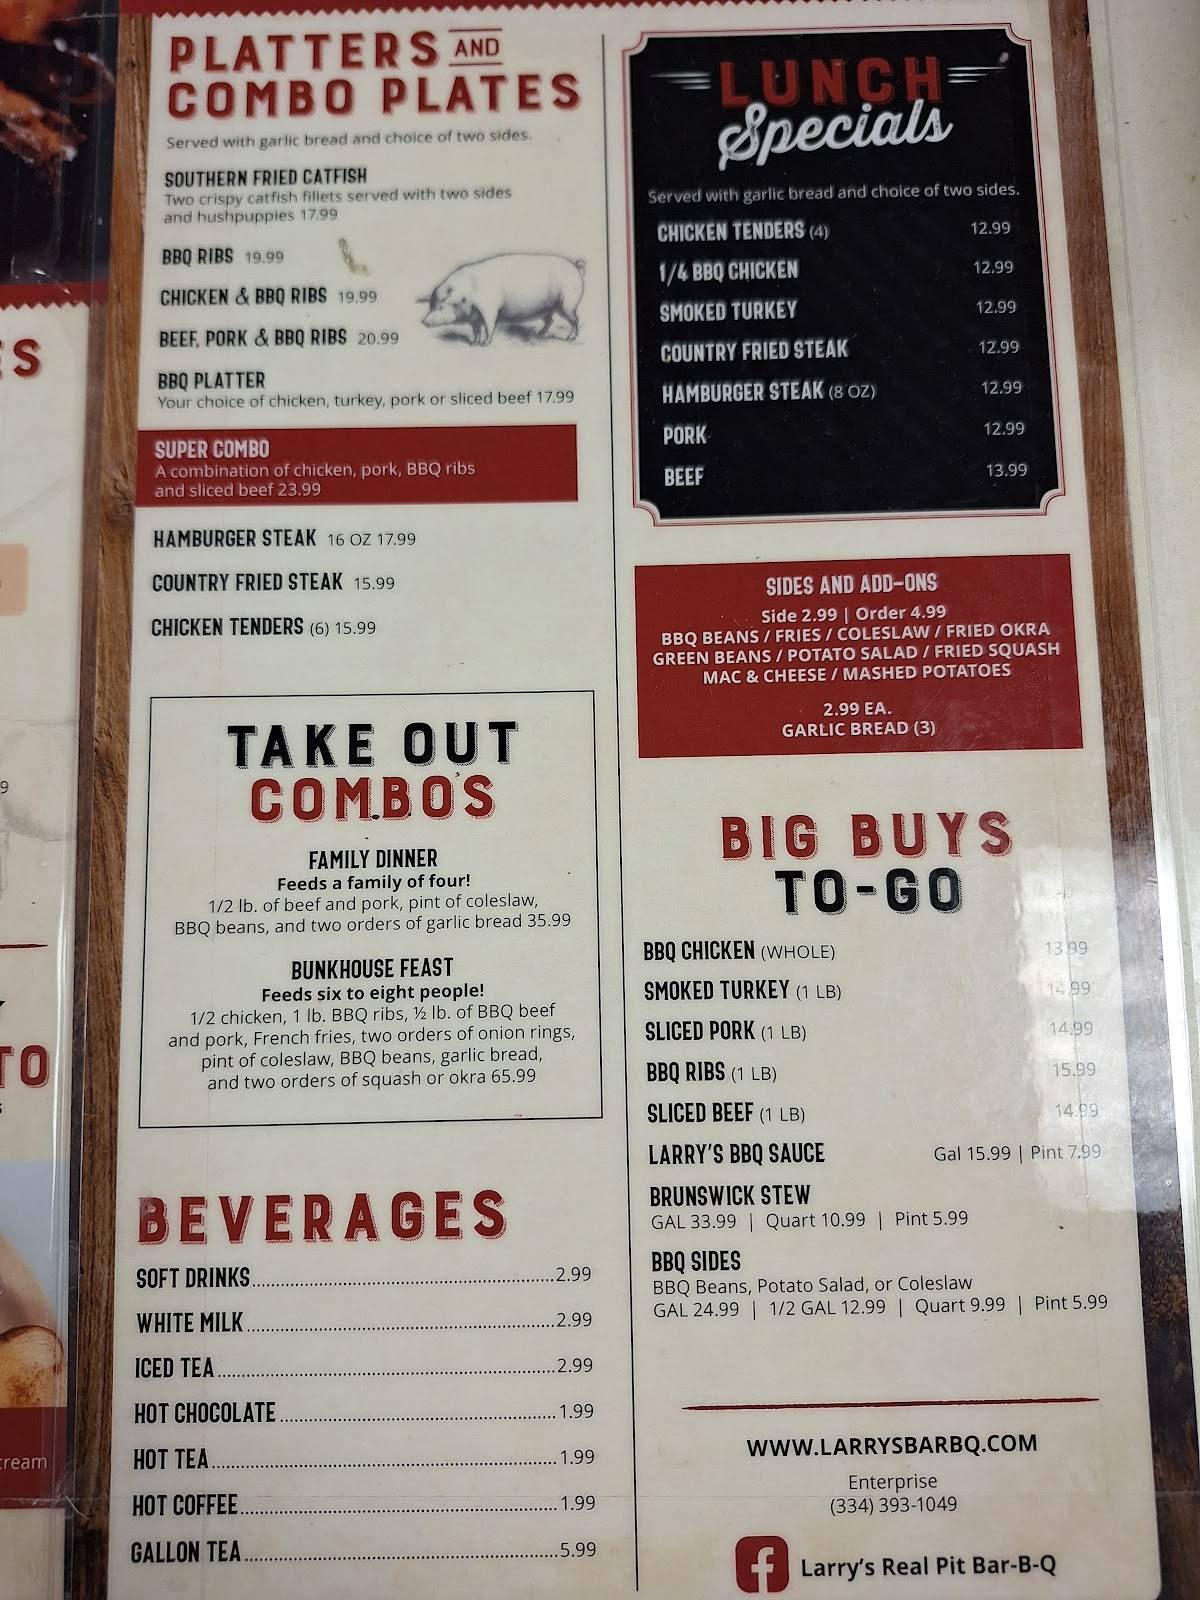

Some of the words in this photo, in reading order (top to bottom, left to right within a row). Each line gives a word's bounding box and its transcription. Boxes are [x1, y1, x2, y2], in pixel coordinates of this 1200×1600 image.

[169, 30, 439, 73] PLATTERS
[453, 38, 500, 58] AND
[718, 56, 944, 108] LUNCH
[168, 78, 354, 119] COMBO
[381, 72, 580, 115] PLATES
[717, 99, 954, 172] Specials
[164, 170, 248, 188] SOUTHERN
[253, 168, 298, 186] FRIED
[303, 167, 367, 185] CATFISH
[163, 210, 193, 225] and
[197, 209, 295, 225] hushpuppies
[300, 207, 338, 222] 17.99
[657, 221, 728, 243] CHICKEN
[731, 220, 806, 241] TENDERS
[809, 225, 830, 241] (4)
[970, 221, 1011, 235] 12.99
[162, 248, 192, 267] BBQ
[197, 247, 234, 265] RIBS
[246, 250, 285, 265] 19.99
[659, 262, 689, 287] 1/4
[692, 261, 725, 283] BBQ
[727, 259, 799, 281] CHICKEN
[973, 260, 1014, 275] 12.99
[160, 288, 229, 307] CHICKEN
[235, 286, 249, 306] &
[255, 287, 285, 307] BBQ
[291, 286, 327, 304] RIBS
[339, 290, 378, 304] 19.99
[659, 301, 727, 323] SMOKED
[730, 299, 798, 321] TURKEY
[976, 300, 1017, 314] 12.99
[159, 330, 199, 348] BEEF,
[205, 329, 247, 347] PORK
[254, 328, 269, 347] &
[274, 328, 305, 348] BBQ
[310, 327, 347, 346] RIBS
[358, 331, 399, 346] 20.99
[660, 341, 738, 363] COUNTRY
[741, 340, 790, 361] FRIED
[793, 338, 849, 360] STEAK
[978, 340, 1020, 355] 12.99
[158, 372, 189, 392] BBQ
[194, 371, 265, 389] PLATTER
[662, 381, 764, 404] HAMBURGER
[768, 380, 824, 401] STEAK
[828, 385, 844, 401] (8
[847, 383, 876, 400] OZ)
[981, 380, 1023, 395] 12.99
[663, 424, 707, 446] PORK
[983, 421, 1025, 436] 12.99
[154, 439, 208, 460] SUPER
[212, 438, 270, 459] COMBO
[155, 464, 167, 479] A
[170, 463, 269, 479] combination
[273, 463, 291, 478] of
[293, 461, 357, 478] chicken,
[361, 461, 402, 480] pork,
[407, 461, 442, 478] BBQ
[446, 460, 476, 475] ribs
[664, 466, 704, 487] BEEF
[986, 463, 1028, 478] 13.99
[154, 483, 185, 498] and
[189, 482, 234, 498] sliced
[238, 482, 275, 497] beef
[277, 482, 321, 497] 23.99
[153, 528, 257, 548] HAMBURGER
[262, 528, 317, 547] STEAK
[328, 533, 345, 547] 16
[349, 533, 372, 547] OZ
[378, 532, 416, 546] 17.99
[152, 573, 230, 593] COUNTRY
[235, 572, 283, 592] FRIED
[288, 572, 343, 591] STEAK
[354, 576, 395, 591] 15.99
[765, 575, 814, 597] SIDES
[819, 574, 855, 595] AND
[859, 572, 938, 594] ADD-ONS
[151, 617, 224, 637] CHICKEN
[229, 616, 304, 636] TENDERS
[310, 621, 330, 638] (6)
[335, 621, 376, 635] 15.99
[781, 722, 846, 738] GARLIC
[850, 721, 909, 736] BREAD
[913, 720, 936, 737] (3)
[227, 723, 375, 770] TAKE
[403, 720, 520, 767] OUT
[720, 814, 819, 862] BIG
[850, 810, 1013, 860] BUYS
[308, 849, 371, 870] FAMILY
[375, 848, 438, 869] DINNER
[277, 876, 328, 891] Feeds
[332, 879, 342, 890] a
[347, 874, 403, 893] family
[407, 873, 426, 889] of
[428, 873, 471, 888] four!
[774, 867, 963, 916] TO-GO
[643, 941, 676, 963] BBQ
[681, 939, 756, 961] CHICKEN
[761, 944, 835, 962] (WHOLE)
[291, 958, 395, 981] BUNKHOUSE
[400, 957, 454, 978] FEAST
[262, 986, 313, 1003] Feeds
[317, 986, 342, 1002] six
[346, 987, 365, 1001] to
[369, 984, 415, 1004] eight
[420, 983, 484, 1003] people!
[729, 1142, 763, 1167] BBQ
[768, 1142, 826, 1164] SAUCE
[649, 1184, 756, 1207] BRUNSWICK
[760, 1184, 811, 1206] STEW
[137, 1189, 507, 1246] BEVERAGES
[136, 1267, 180, 1289] SOFT
[185, 1266, 250, 1289] DRINKS
[556, 1266, 592, 1282] 2.99
[653, 1279, 690, 1298] BBQ
[696, 1279, 752, 1296] Beans,
[758, 1278, 814, 1294] Potato
[818, 1276, 869, 1294] Salad,
[874, 1279, 893, 1292] or
[897, 1274, 973, 1291] Coleslaw
[136, 1312, 195, 1334] WHITE
[199, 1311, 244, 1333] MILK
[556, 1311, 592, 1328] 2.99
[135, 1357, 174, 1379] ICED
[179, 1356, 215, 1378] TEA
[557, 1357, 593, 1373] 2.99
[134, 1402, 170, 1424] HOT
[174, 1401, 277, 1424] CHOCOLATE
[559, 1403, 594, 1419] 1.99
[746, 1433, 1038, 1457] WWW.LARRYSBARBQ.COM
[133, 1448, 169, 1470] HOT
[174, 1447, 209, 1470] TEA
[560, 1449, 595, 1465] 1.99
[848, 1473, 938, 1493] Enterprise
[132, 1494, 168, 1517] HOT
[172, 1493, 239, 1517] COFFEE
[561, 1495, 596, 1511] 1.99
[830, 1497, 874, 1517] (334)
[879, 1495, 958, 1513] 393-1049
[130, 1541, 201, 1564] GALLON
[206, 1540, 242, 1563] TEA
[560, 1541, 597, 1558] 5.99
[882, 1555, 929, 1576] Real
[936, 1555, 966, 1575] Pit
[972, 1554, 1057, 1577] Bar-B-Q
